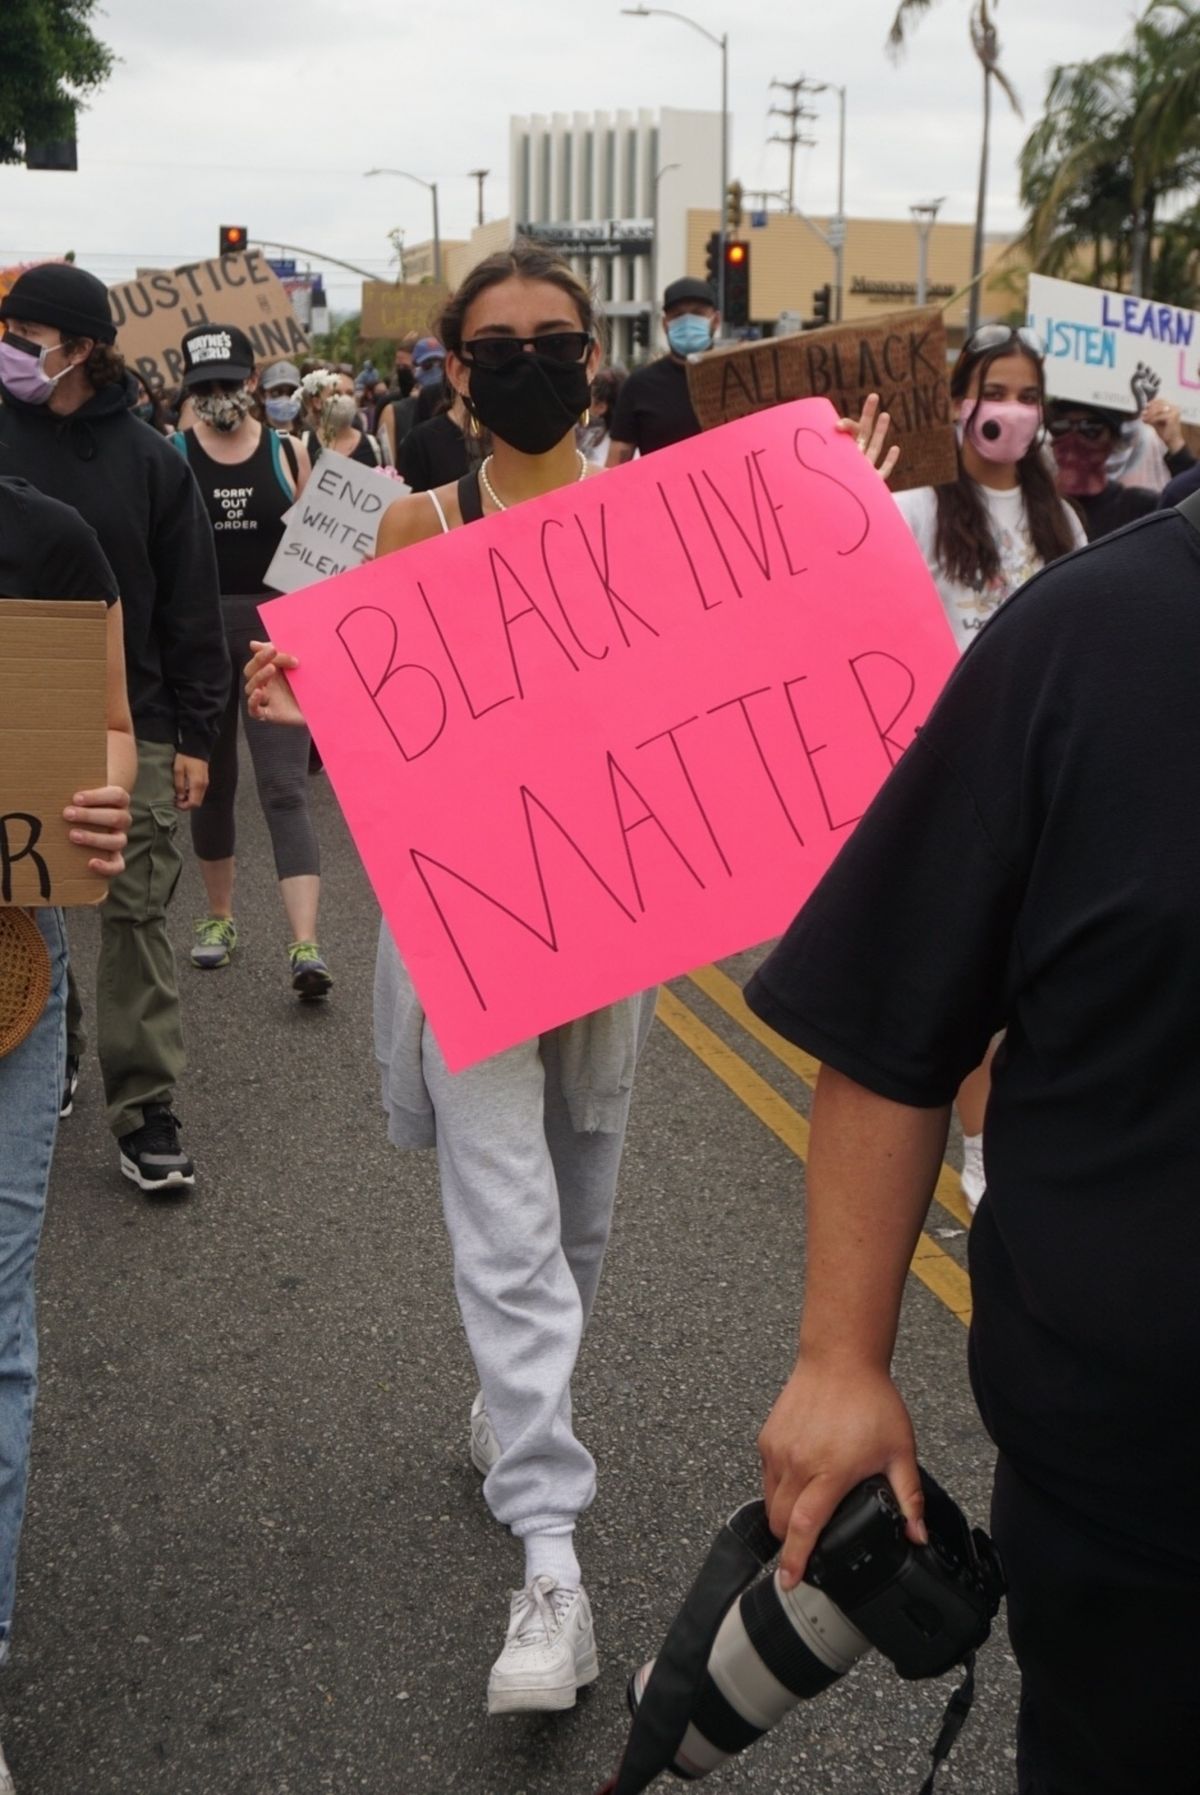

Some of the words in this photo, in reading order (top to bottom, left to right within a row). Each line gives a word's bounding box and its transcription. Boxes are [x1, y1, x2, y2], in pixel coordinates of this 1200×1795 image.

[109, 250, 268, 327] JUSTICE
[1102, 294, 1194, 346] LEARN
[136, 316, 311, 391] BRNNA
[190, 347, 231, 364] WORLD
[807, 330, 941, 398] BLACK
[721, 349, 781, 410] ALL
[213, 488, 254, 498] SORRY
[221, 498, 248, 508] OUT
[227, 509, 244, 519] OF
[317, 469, 382, 513] END
[214, 520, 258, 530] ORDER
[302, 506, 375, 554] WHITE
[335, 503, 661, 762] BLACK
[657, 428, 871, 611] LIVES
[410, 651, 915, 1012] MATTER
